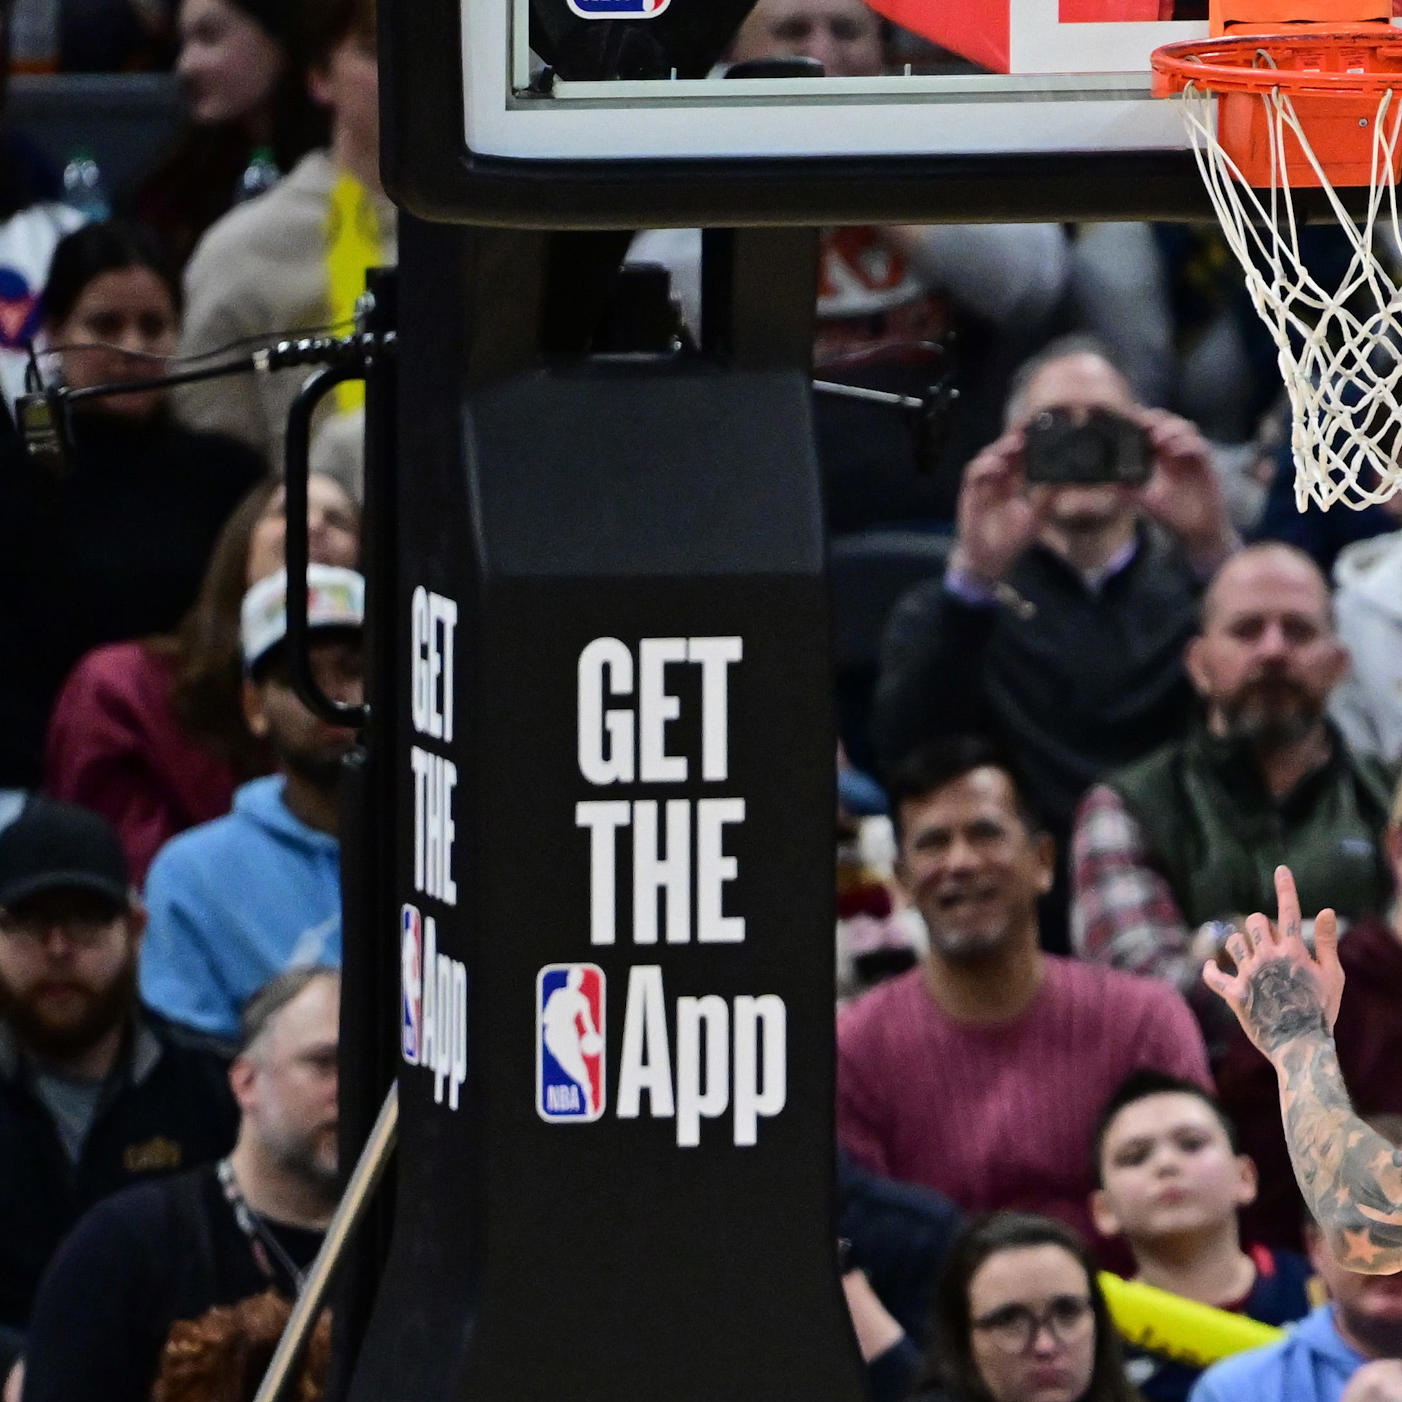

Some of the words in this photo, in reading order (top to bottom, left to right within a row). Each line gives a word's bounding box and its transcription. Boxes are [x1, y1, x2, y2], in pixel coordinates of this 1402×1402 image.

[411, 585, 457, 743] GET
[577, 636, 743, 785] GET
[411, 745, 456, 905] THE
[575, 798, 746, 945] THE
[422, 916, 467, 1111] App
[616, 965, 787, 1147] App
